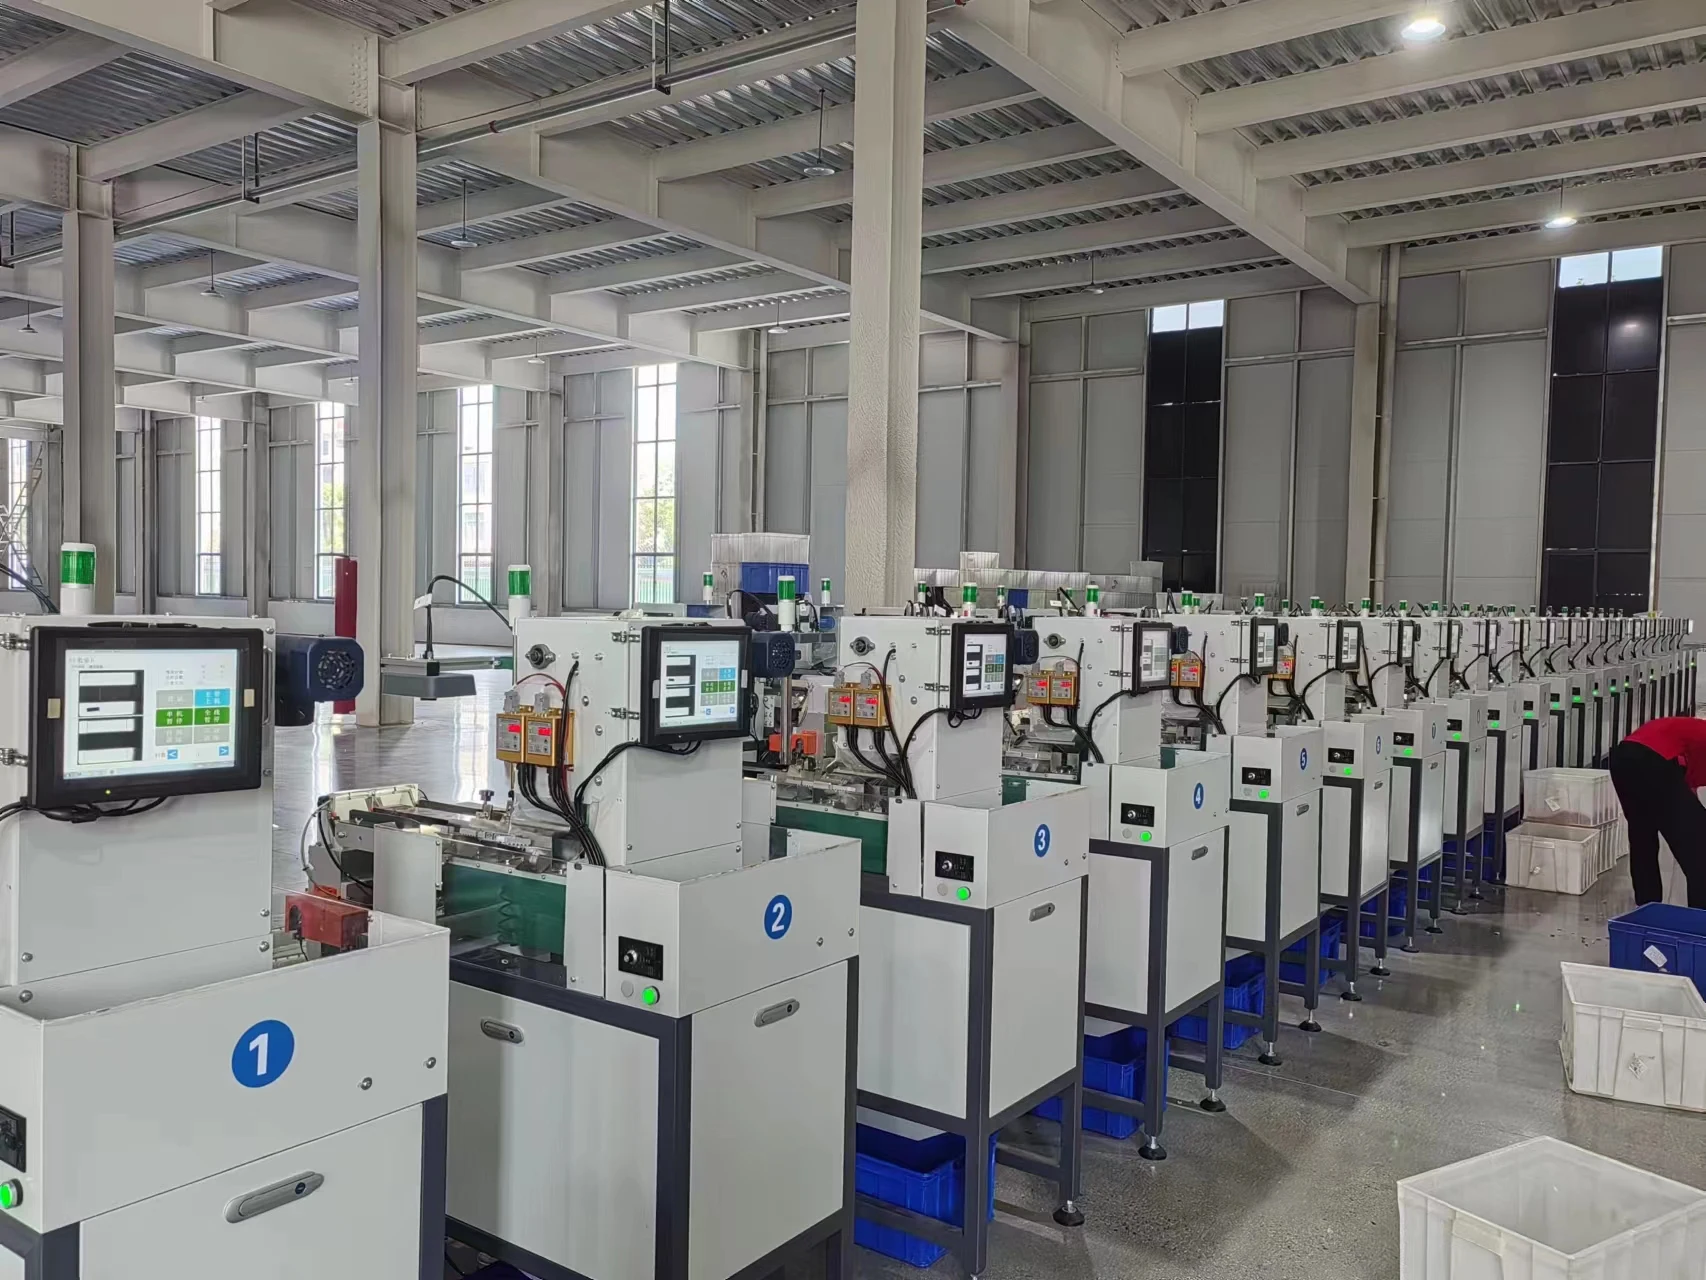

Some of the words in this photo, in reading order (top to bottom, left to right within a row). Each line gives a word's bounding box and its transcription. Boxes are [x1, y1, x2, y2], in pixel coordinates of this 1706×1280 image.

[1195, 787, 1201, 805] 4
[1038, 829, 1046, 851] 3
[771, 902, 785, 932] 2
[248, 1033, 269, 1076] 1
